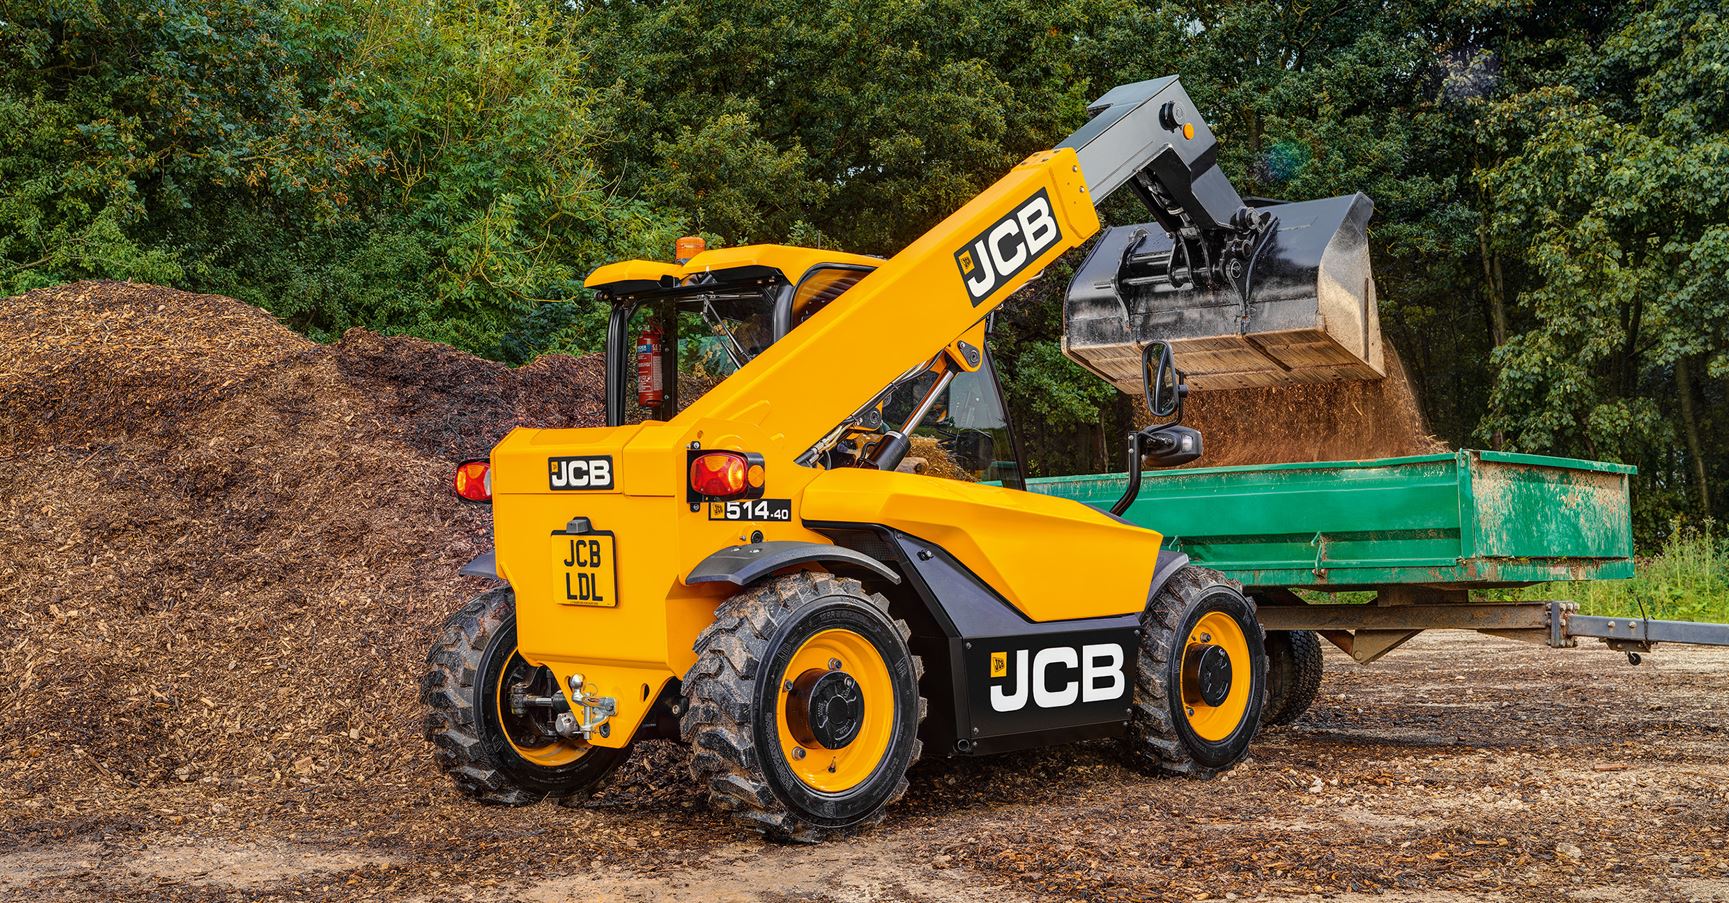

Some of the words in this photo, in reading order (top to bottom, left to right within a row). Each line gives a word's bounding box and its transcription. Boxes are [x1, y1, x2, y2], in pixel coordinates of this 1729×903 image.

[967, 196, 1057, 298] JCB
[551, 460, 611, 487] JCB
[563, 540, 601, 568] JCB
[566, 572, 604, 601] LDL
[990, 643, 1126, 713] JCB
